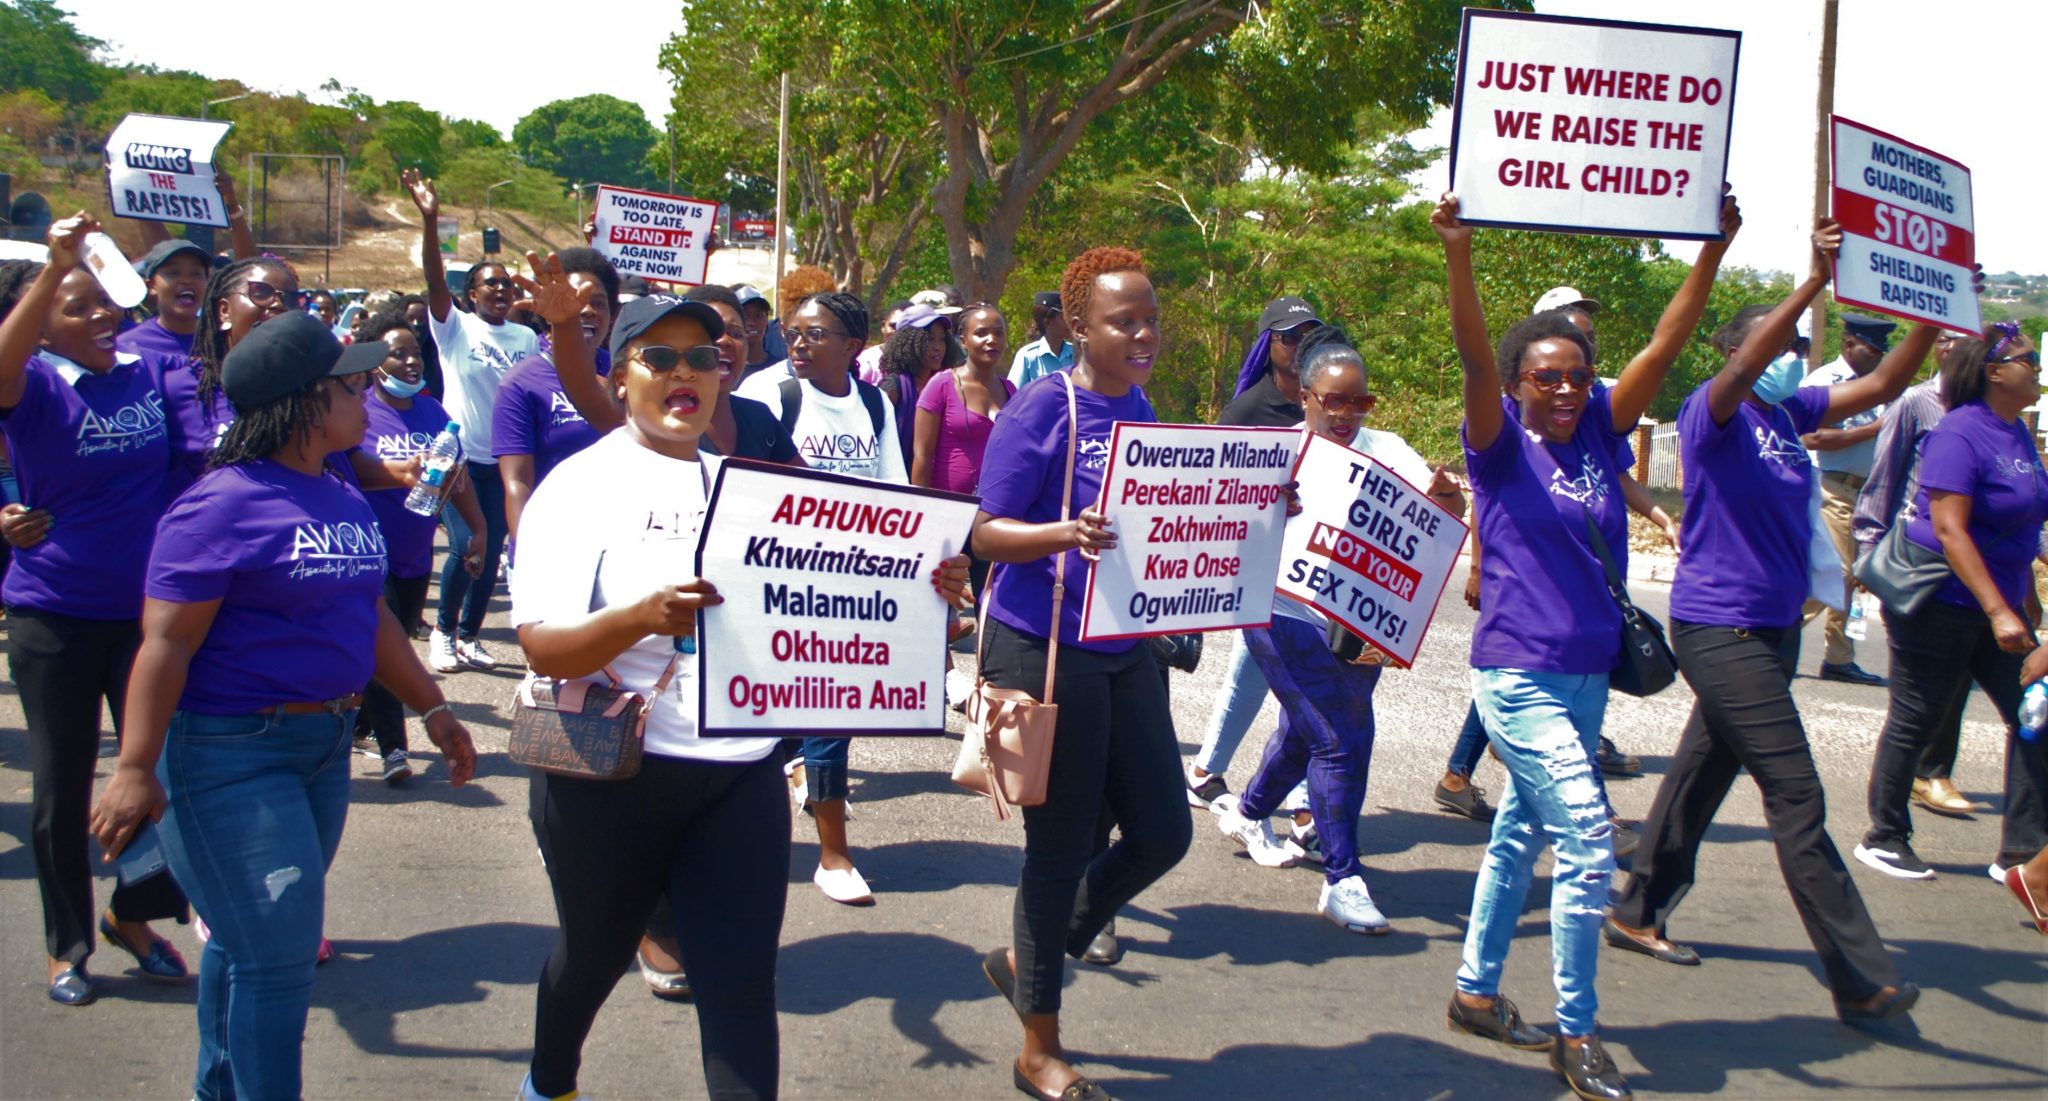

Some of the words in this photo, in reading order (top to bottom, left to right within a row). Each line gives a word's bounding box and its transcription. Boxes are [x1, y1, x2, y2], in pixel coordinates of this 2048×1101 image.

[1477, 61, 1555, 93] JUST
[1564, 67, 1670, 101] WHERE
[1679, 75, 1722, 106] DO
[1494, 109, 1542, 140] WE
[1552, 114, 1637, 147] RAISE
[1648, 121, 1703, 152] THE
[128, 143, 188, 172] HUNG
[1871, 141, 1946, 189] MOTHERS,
[148, 173, 177, 190] THE
[1498, 158, 1570, 190] GIRL
[1581, 164, 1690, 198] CHILD?
[1863, 166, 1955, 214] GUARDIANS
[124, 189, 212, 220] RAPISTS!
[611, 195, 688, 216] TOMORROW
[690, 207, 703, 218] IS
[623, 210, 650, 224] TOO
[654, 216, 685, 230] LATE,
[613, 227, 666, 243] STAND
[671, 234, 692, 248] UP
[620, 245, 677, 262] AGAINST
[611, 257, 642, 271] RAPE
[646, 262, 683, 277] NOW!
[1870, 251, 1955, 293] SHIELDING
[1880, 280, 1948, 317] RAPISTS!
[1126, 439, 1215, 468] Oweruza
[1220, 442, 1290, 468] Milandu
[1121, 478, 1213, 506] Perekani
[1215, 478, 1281, 510] Zilango
[1348, 462, 1403, 509] THEY
[1401, 500, 1441, 538] ARE
[772, 494, 923, 538] APHUNGU
[1147, 515, 1248, 543] Zokhwima
[1348, 499, 1419, 561] GIRLS
[744, 536, 924, 580] Khwimitsani
[1144, 554, 1189, 580] Kwa
[1193, 552, 1240, 577] Onse
[1313, 526, 1365, 564] NOT
[1366, 555, 1414, 602] YOUR
[764, 583, 898, 622] Malamulo
[1129, 586, 1243, 623] Ogwililira!
[1287, 559, 1345, 603] SEX
[1347, 588, 1408, 644] TOYS!
[771, 630, 890, 666] Okhudza
[729, 675, 861, 716] Ogwililira
[869, 680, 926, 710] Ana!
